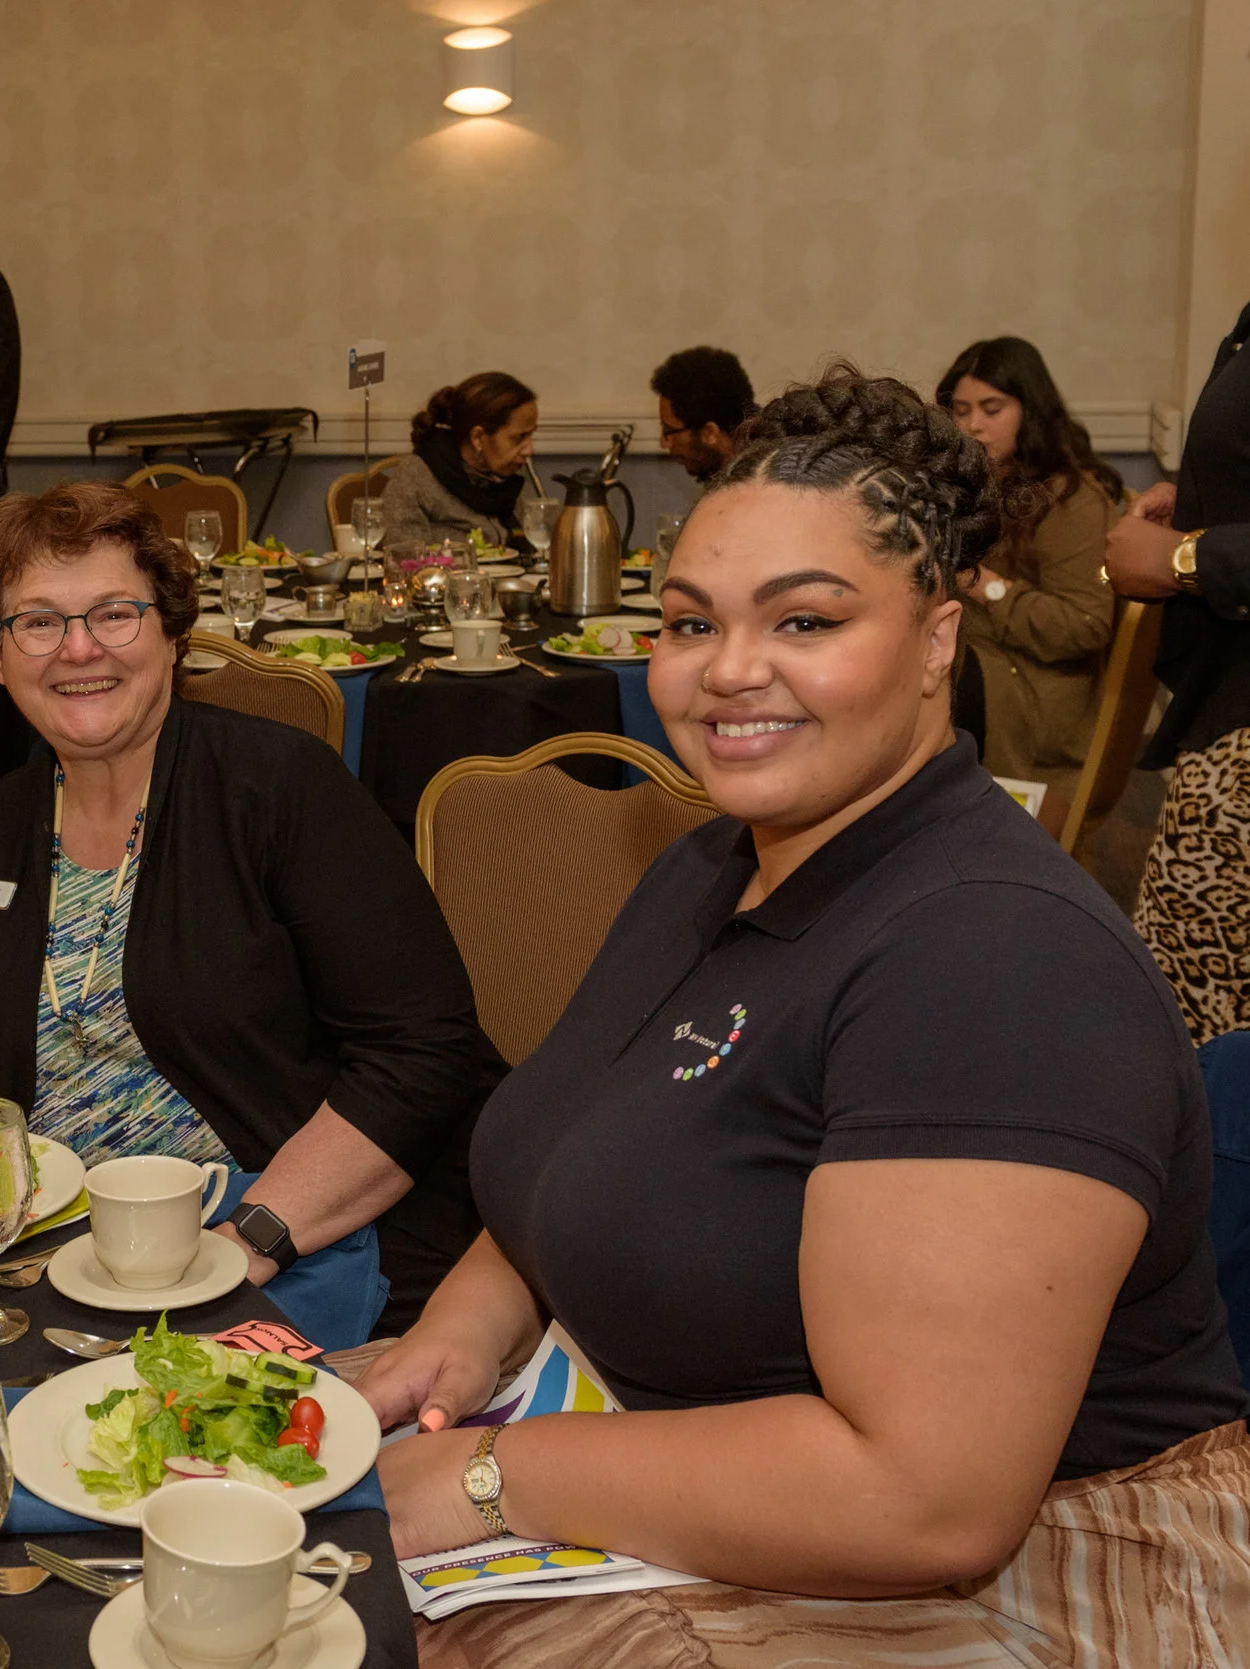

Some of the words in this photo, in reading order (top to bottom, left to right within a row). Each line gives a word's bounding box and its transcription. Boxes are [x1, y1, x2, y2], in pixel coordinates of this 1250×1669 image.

[412, 1567, 440, 1577] OUR
[444, 1552, 511, 1569] PRESENCE
[515, 1548, 542, 1556] HAS
